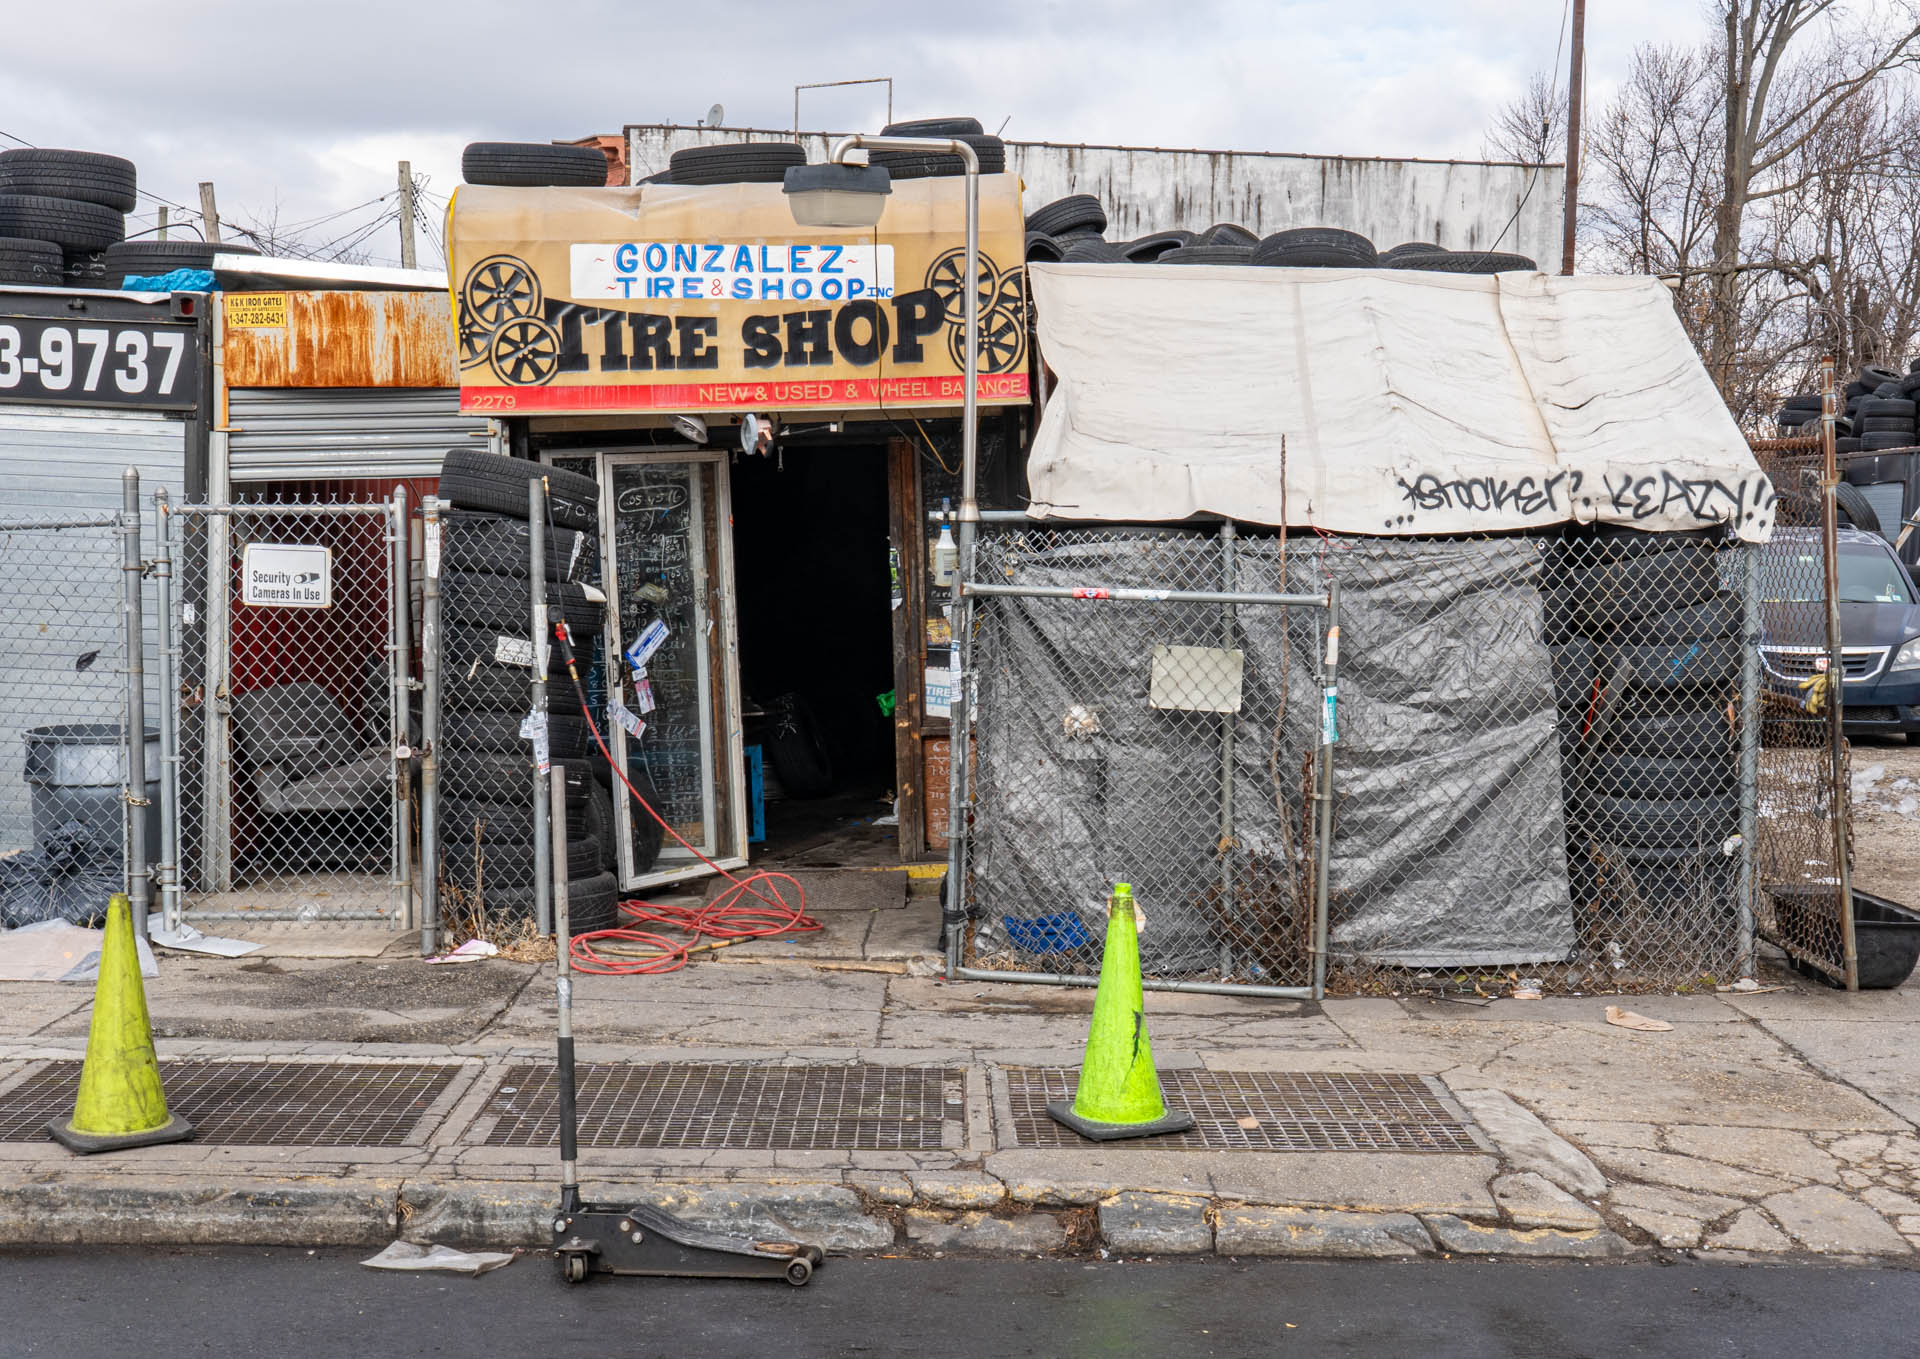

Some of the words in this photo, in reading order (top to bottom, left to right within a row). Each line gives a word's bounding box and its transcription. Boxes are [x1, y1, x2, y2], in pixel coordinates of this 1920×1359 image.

[613, 243, 844, 273] GONZALEZ
[615, 277, 704, 299] TIRE
[731, 278, 865, 300] SHOOP
[866, 286, 893, 298] INC
[245, 297, 262, 306] IRON
[263, 297, 282, 306] GATES
[544, 297, 719, 372] TIRE
[741, 288, 946, 370] SHOP
[0, 325, 185, 394] 3-9737
[472, 395, 516, 409] 2279
[699, 387, 748, 402] NEW
[754, 385, 769, 401] &
[775, 384, 833, 401] USED
[846, 383, 858, 398] &
[870, 382, 931, 397] WHEEL
[941, 379, 1023, 396] BAANCE
[252, 570, 291, 586] Security
[252, 585, 290, 599] Cameras
[293, 587, 302, 600] In
[304, 588, 321, 600] Use
